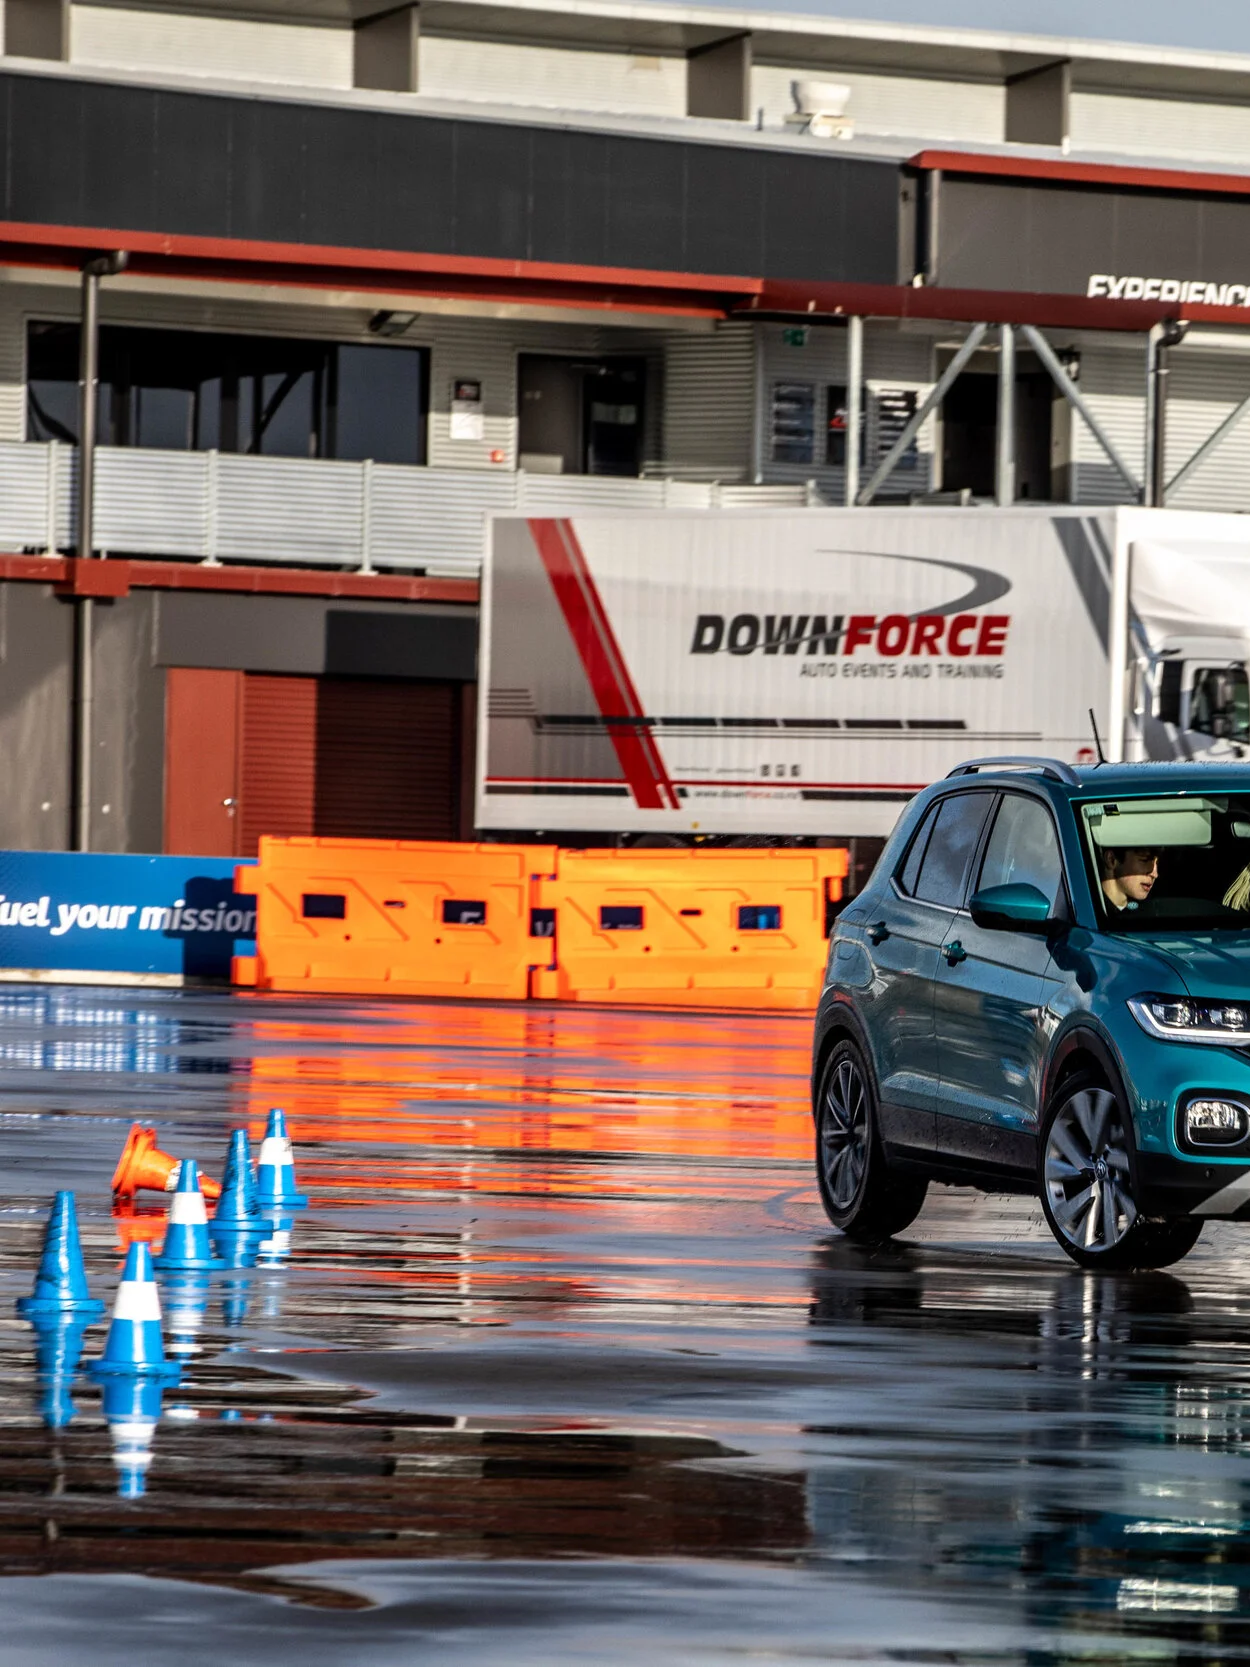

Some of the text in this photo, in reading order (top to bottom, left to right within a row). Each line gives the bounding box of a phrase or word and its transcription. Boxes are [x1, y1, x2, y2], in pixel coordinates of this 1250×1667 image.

[690, 613, 1011, 657] DOWNFORCE
[800, 662, 1005, 679] AUTO EVENTS AND TRAINING
[0, 895, 50, 927] uel
[50, 903, 137, 936] your
